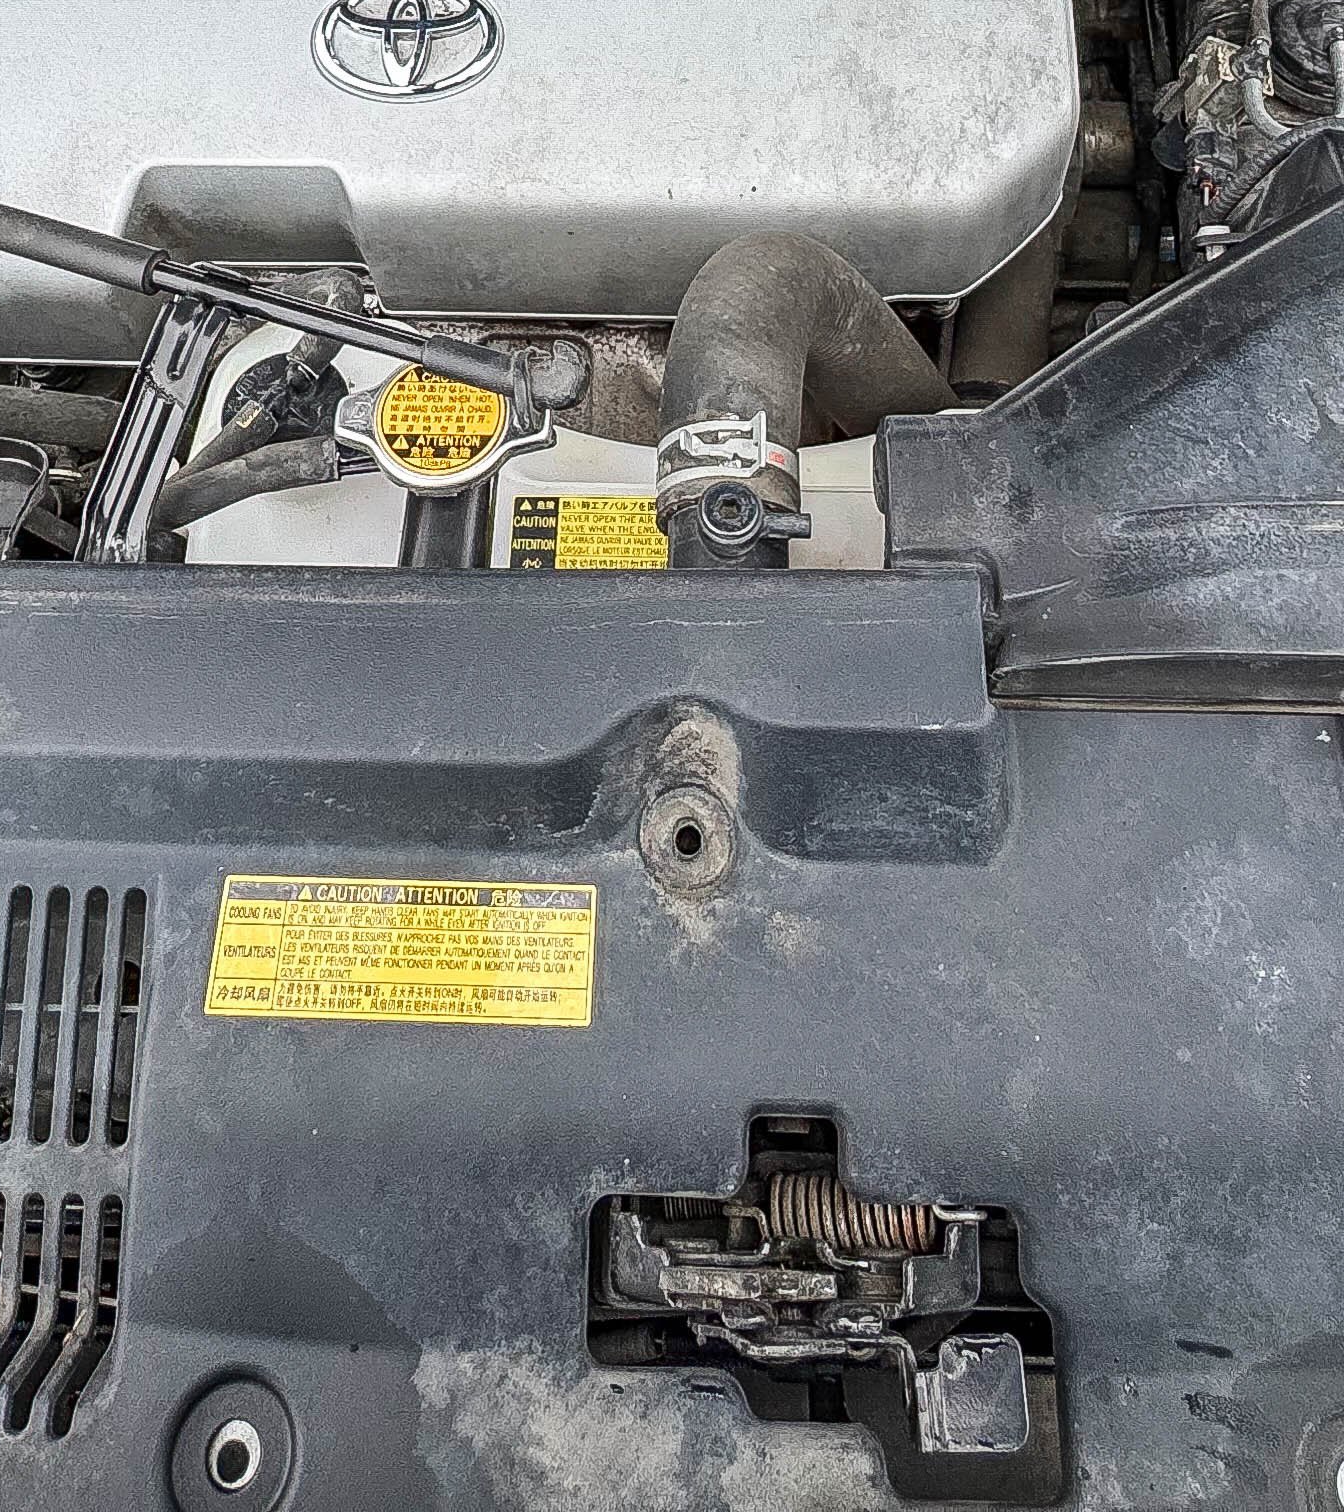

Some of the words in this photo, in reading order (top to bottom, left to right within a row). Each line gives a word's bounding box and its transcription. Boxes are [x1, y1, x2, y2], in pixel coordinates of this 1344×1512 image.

[416, 435, 480, 447] ATTENTION
[514, 516, 556, 528] CAUTION
[561, 515, 590, 523] NEVER
[593, 515, 616, 523] OPEN
[619, 515, 636, 523] THE
[639, 515, 654, 524] AIR
[588, 526, 615, 534] WHEN
[617, 526, 634, 535] THE
[637, 526, 660, 534] ENG
[512, 539, 555, 551] ATTENTION
[315, 884, 382, 902] CAUTION
[394, 886, 478, 904] ATTENTION
[228, 905, 260, 919] COOLING
[262, 906, 282, 919] FANS
[222, 944, 276, 958] VENTILATEURS
